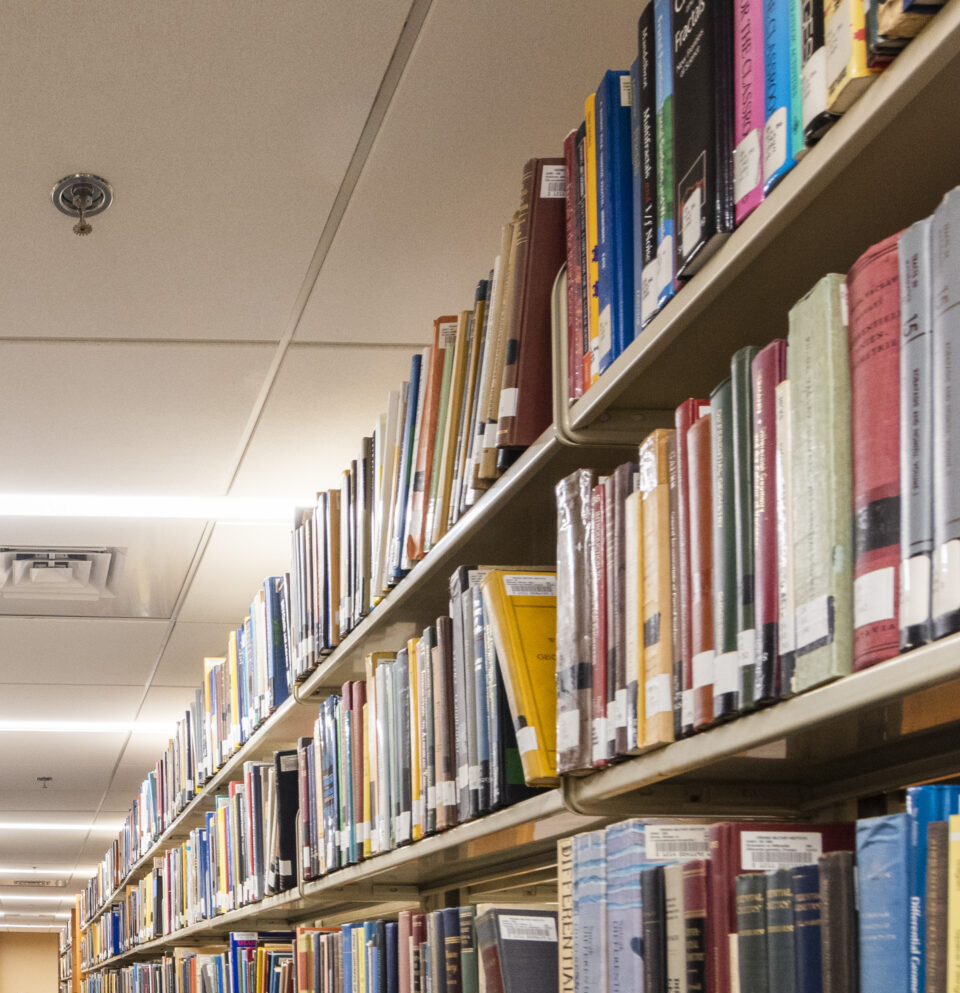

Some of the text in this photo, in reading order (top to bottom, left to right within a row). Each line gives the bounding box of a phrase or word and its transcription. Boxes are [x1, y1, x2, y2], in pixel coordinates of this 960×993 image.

[643, 106, 652, 180] Multifractals
[645, 227, 655, 262] Noise
[910, 896, 921, 954] Differential
